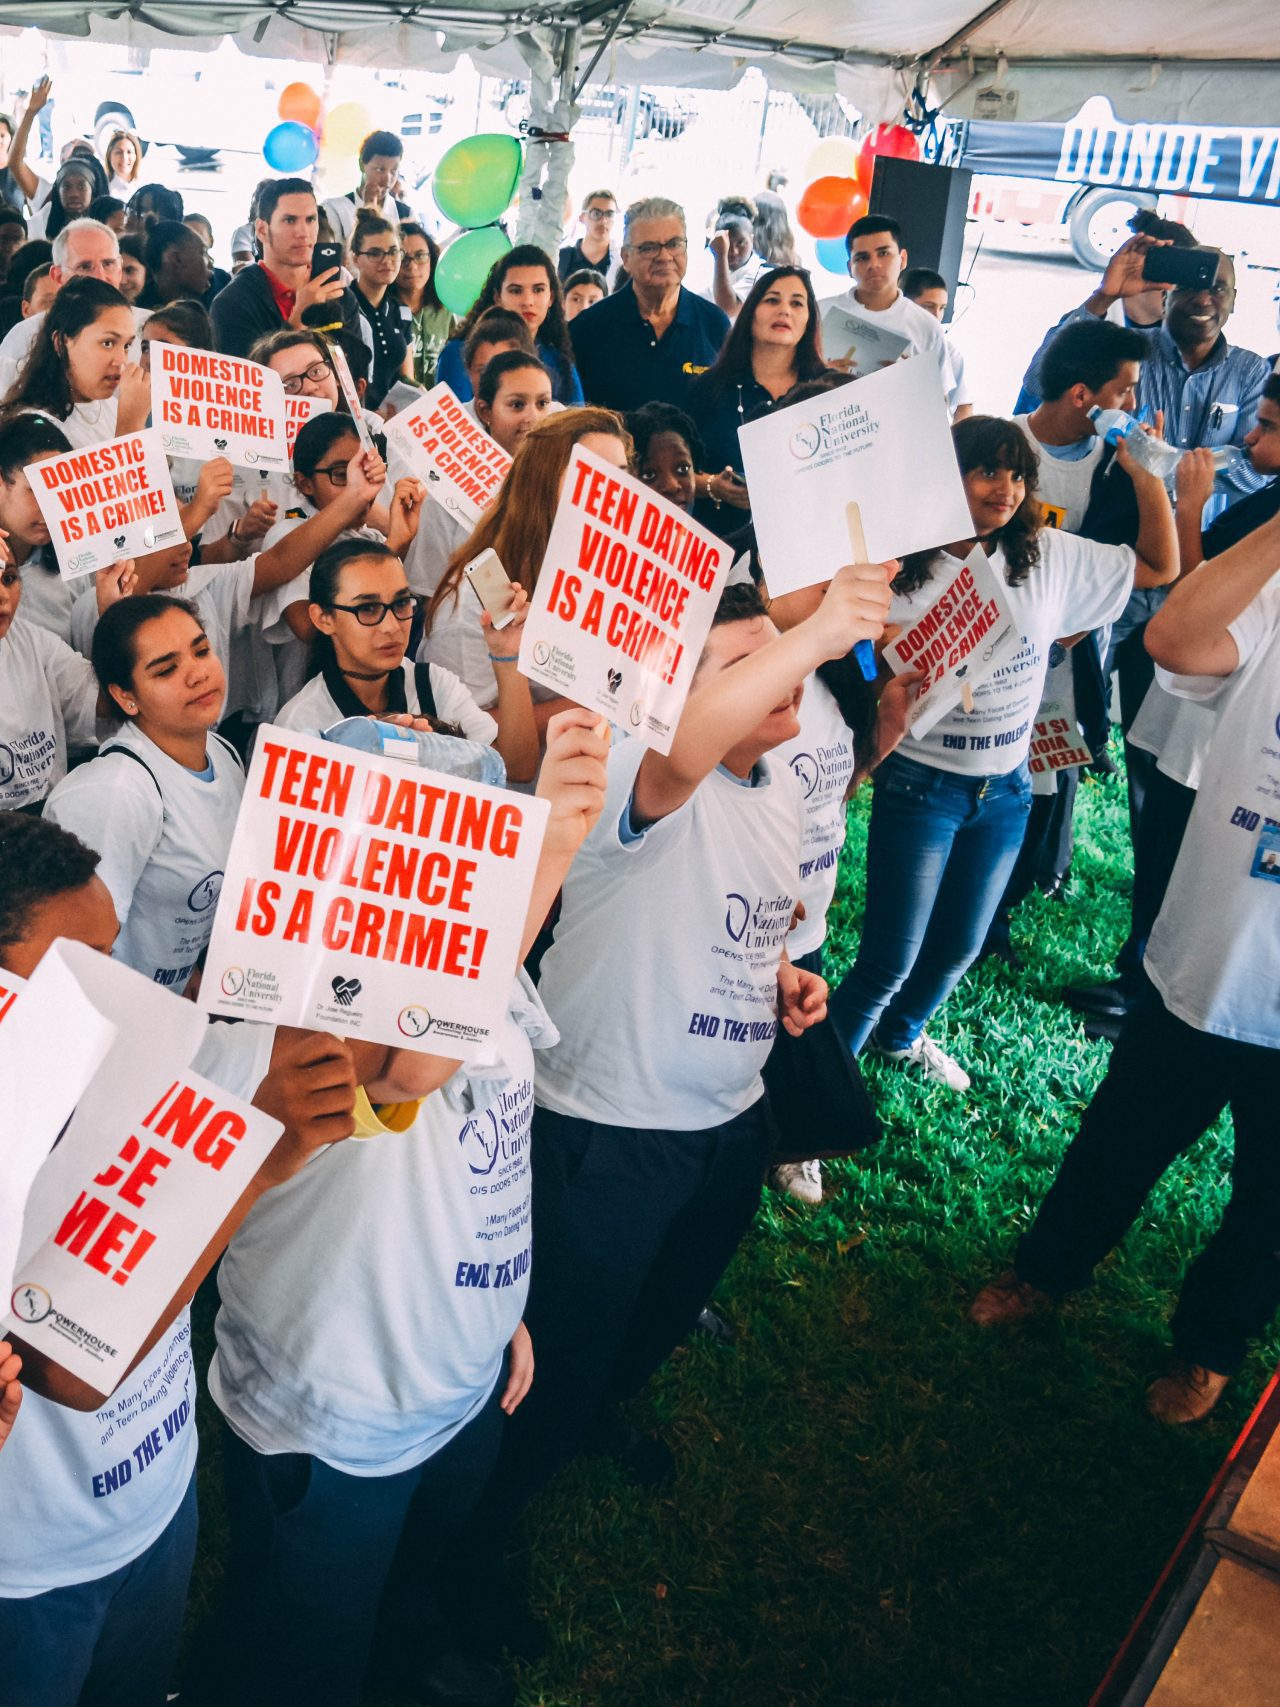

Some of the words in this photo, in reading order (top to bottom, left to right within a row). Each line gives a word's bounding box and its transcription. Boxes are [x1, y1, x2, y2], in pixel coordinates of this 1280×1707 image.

[1055, 122, 1224, 195] DONDE
[162, 349, 263, 387] DOMESTIC
[169, 376, 262, 412] VIOLENCE
[162, 401, 182, 424] IS
[187, 405, 201, 426] A
[206, 407, 274, 439] CRIME!
[408, 415, 429, 438] IS
[422, 437, 439, 454] A
[820, 403, 861, 427] Florida
[822, 410, 869, 437] National
[824, 420, 880, 449] University
[428, 410, 500, 490] VIOLENCE
[437, 394, 513, 478] DOMESTIC
[40, 438, 145, 490] DOMESTIC
[57, 466, 149, 513] VIOLENCE
[571, 459, 639, 537] TEEN
[60, 517, 84, 543] IS
[86, 511, 101, 536] A
[102, 490, 166, 530] CRIME!
[636, 502, 720, 593] DATING
[577, 524, 690, 630] VIOLENCE
[546, 568, 582, 622] IS
[580, 590, 605, 637] A
[606, 602, 684, 684] CRIME!
[894, 566, 975, 664] DOMESTIC
[912, 589, 983, 673] VIOLENCE
[934, 663, 945, 683] A
[948, 599, 1001, 667] CRIME!
[9, 731, 46, 752] Florida
[15, 734, 56, 765] National
[943, 734, 966, 749] END
[970, 735, 992, 751] THE
[1047, 748, 1089, 767] TEEN
[260, 742, 355, 817] TEEN
[359, 770, 524, 859] DATING
[1230, 806, 1260, 832] END
[273, 816, 478, 913] VIOLENCE
[235, 877, 281, 937] IS
[282, 888, 314, 944] A
[321, 896, 488, 980] CRIME!
[711, 945, 743, 962] OPENS
[154, 968, 177, 986] END
[247, 968, 276, 981] Florida
[709, 986, 726, 997] and
[720, 974, 734, 987] The
[431, 1018, 490, 1036] POWERHOUSE
[688, 1012, 720, 1038] END
[722, 1018, 750, 1043] THE
[470, 1119, 494, 1158] FNU
[490, 1180, 511, 1195] DOORS
[511, 1174, 519, 1185] TO
[476, 1230, 493, 1241] and
[455, 1261, 490, 1289] END
[50, 1309, 118, 1358] POWERHOUSE
[96, 1410, 115, 1425] The
[117, 1389, 142, 1412] Many
[143, 1367, 162, 1393] Faces
[100, 1425, 114, 1446] and
[116, 1411, 138, 1429] Teen
[140, 1383, 168, 1412] Dating
[162, 1350, 189, 1385] Violence
[92, 1459, 132, 1498] END
[133, 1427, 163, 1474] THE
